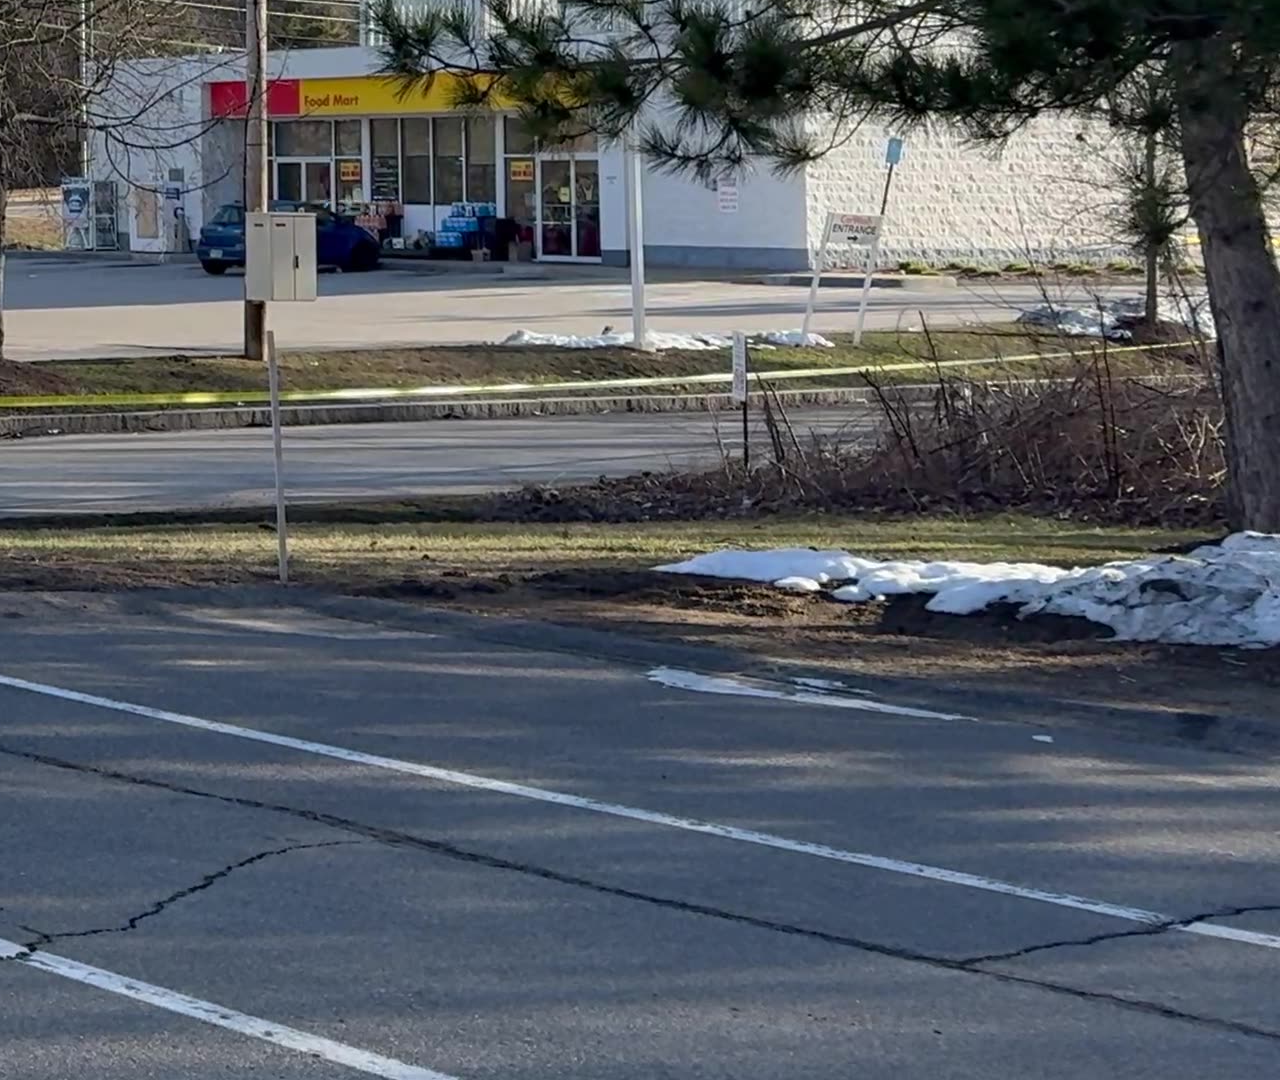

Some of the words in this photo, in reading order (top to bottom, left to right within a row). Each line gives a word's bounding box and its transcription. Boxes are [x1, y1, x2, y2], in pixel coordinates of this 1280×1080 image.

[304, 94, 330, 108] Food
[333, 94, 359, 107] Mart
[832, 223, 877, 236] ENTRANCE
